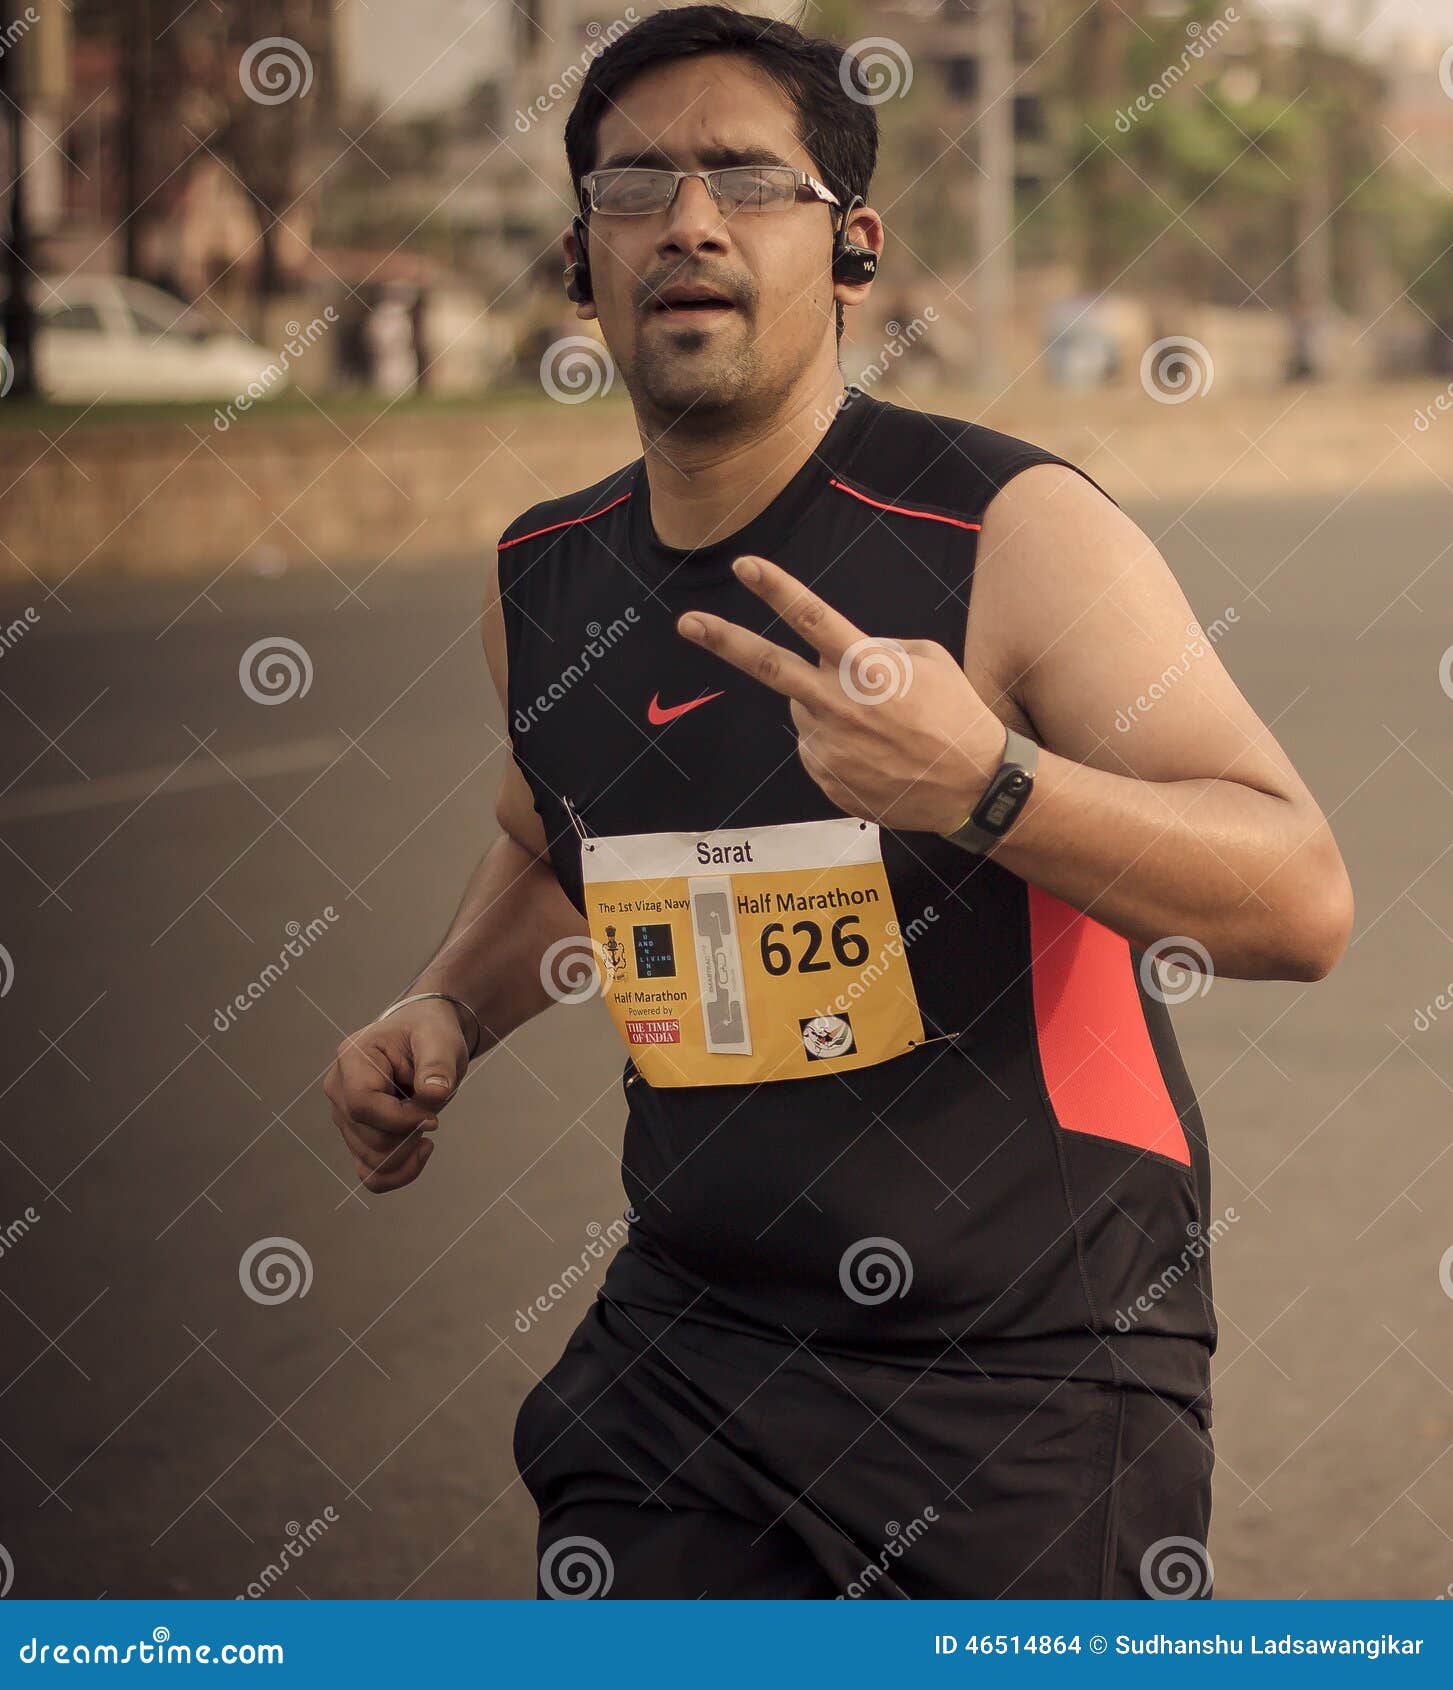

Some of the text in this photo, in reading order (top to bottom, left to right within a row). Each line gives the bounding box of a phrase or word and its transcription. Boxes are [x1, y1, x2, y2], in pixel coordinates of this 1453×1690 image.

[696, 840, 753, 865] Sarat
[598, 899, 690, 913] The 1st Vizag Navy
[737, 887, 880, 914] Half Marathon
[760, 915, 870, 976] 626
[614, 989, 688, 1004] Half Marathon
[628, 1005, 673, 1016] Powered by
[627, 1020, 679, 1033] THE TIMES
[632, 1032, 675, 1043] OF INDIA
